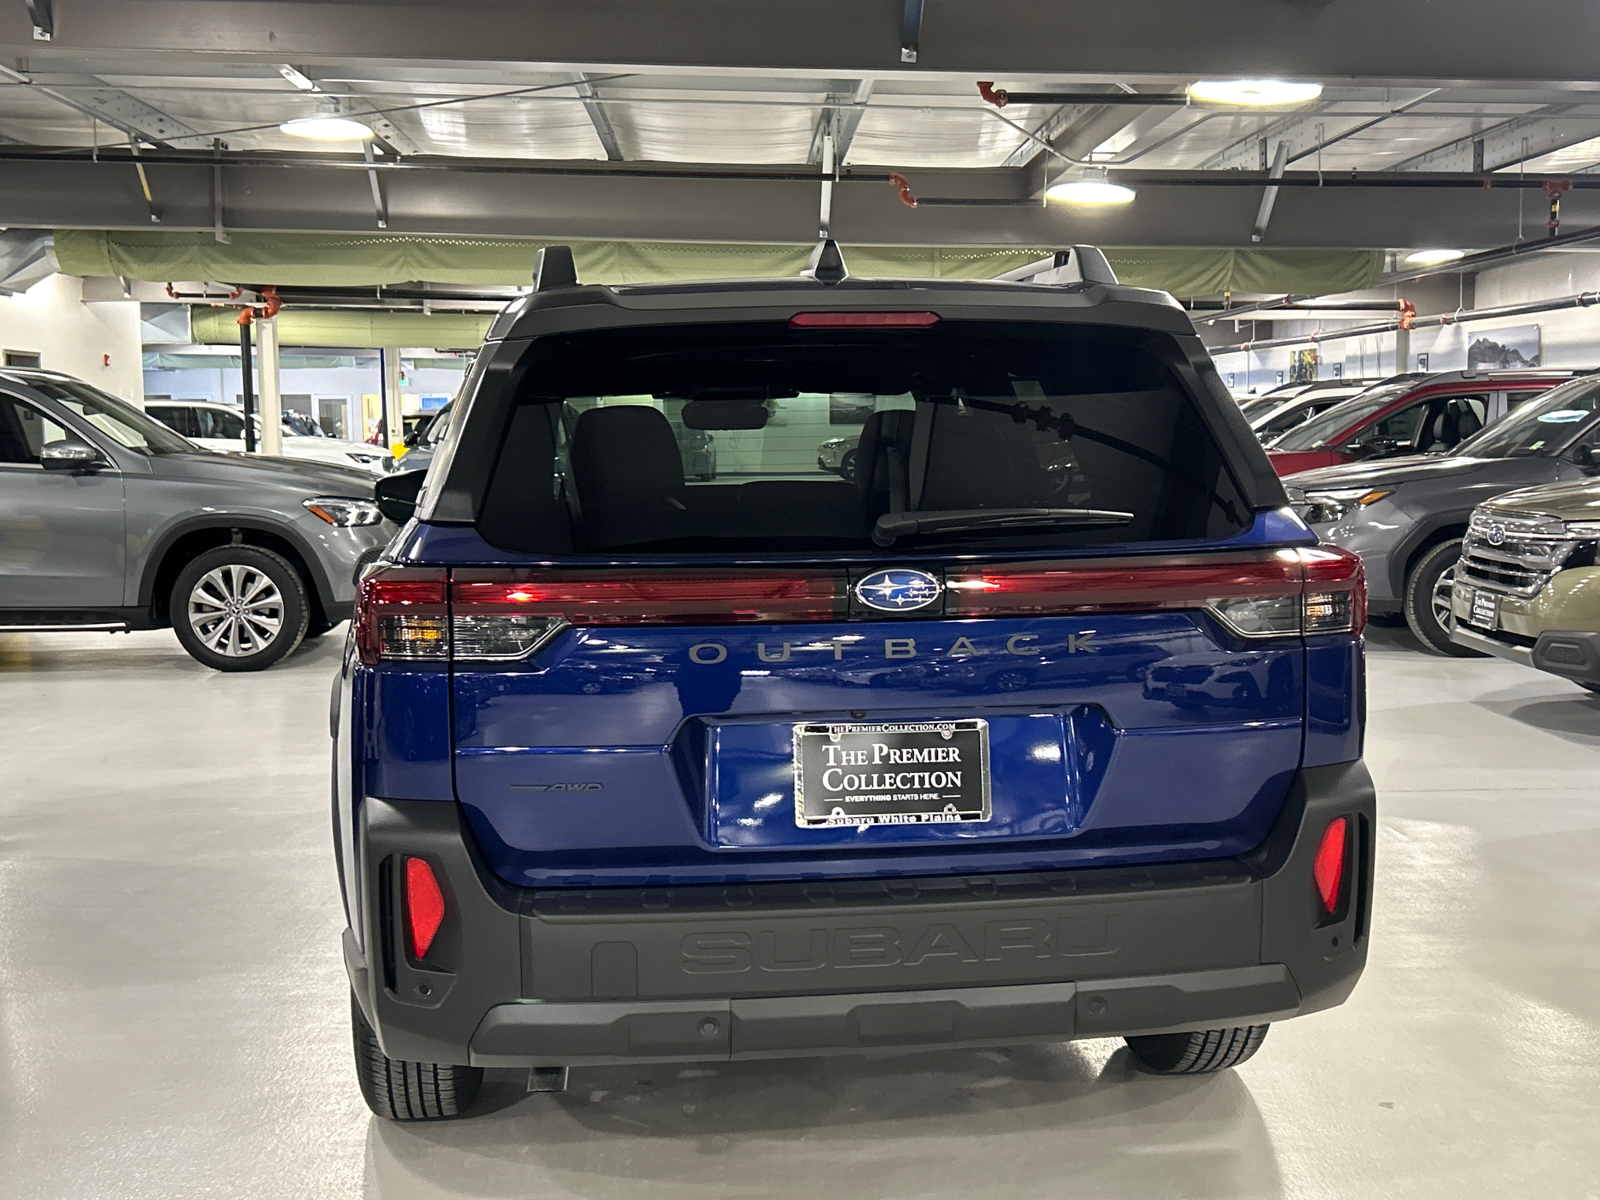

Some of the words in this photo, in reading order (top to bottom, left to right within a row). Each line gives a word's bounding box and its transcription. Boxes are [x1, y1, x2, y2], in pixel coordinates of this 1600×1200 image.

[688, 630, 1098, 665] OUTBACK
[822, 745, 868, 766] THE
[871, 743, 962, 764] PREMIER
[545, 782, 604, 793] AWD
[822, 768, 962, 791] COLLECTION
[827, 816, 874, 826] Subaru
[878, 814, 917, 824] White
[921, 812, 962, 822] Plains
[681, 914, 1122, 974] SUBARU
